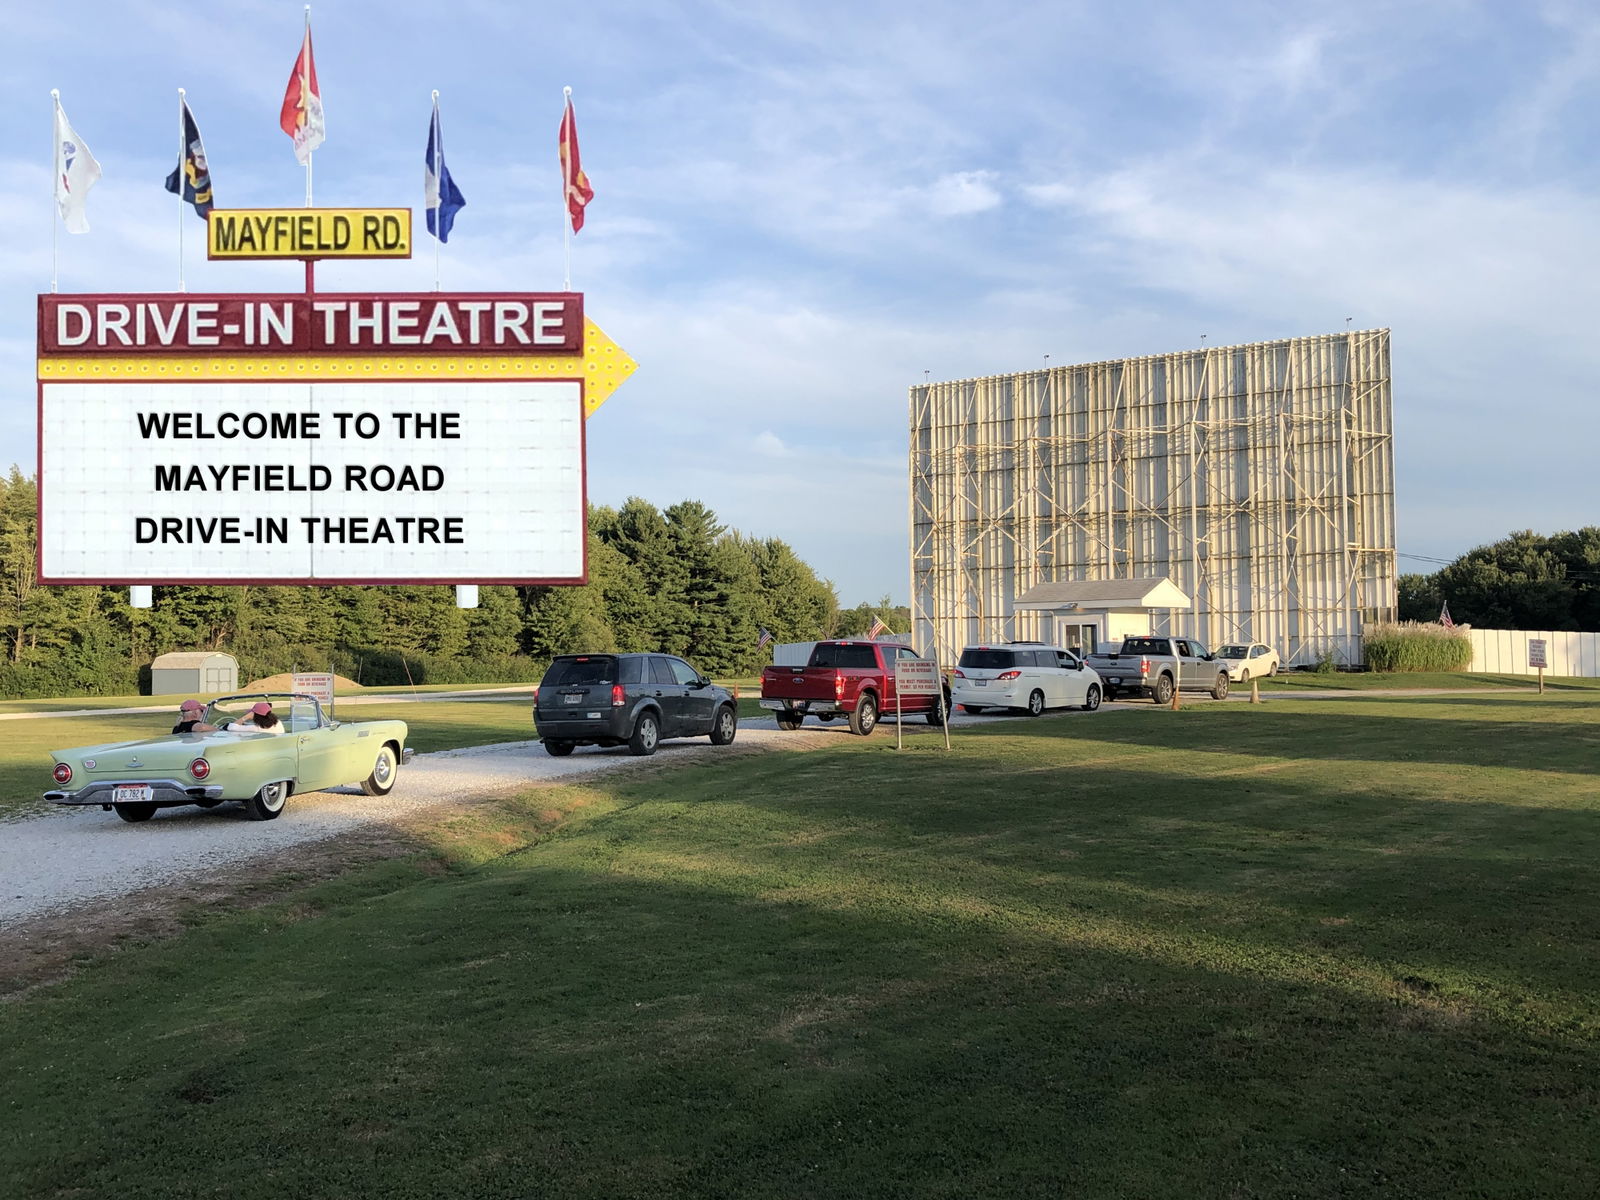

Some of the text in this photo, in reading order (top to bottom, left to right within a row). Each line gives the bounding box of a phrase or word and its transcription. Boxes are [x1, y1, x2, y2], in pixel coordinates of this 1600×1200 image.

[215, 215, 406, 252] MAYFIELD RD.
[56, 300, 566, 347] DRIVE-IN THEATRE
[137, 412, 461, 440] WELCOME TO THE
[155, 464, 445, 492] MAYFIELD ROAD
[135, 517, 464, 544] DRIVE-IN THEATRE
